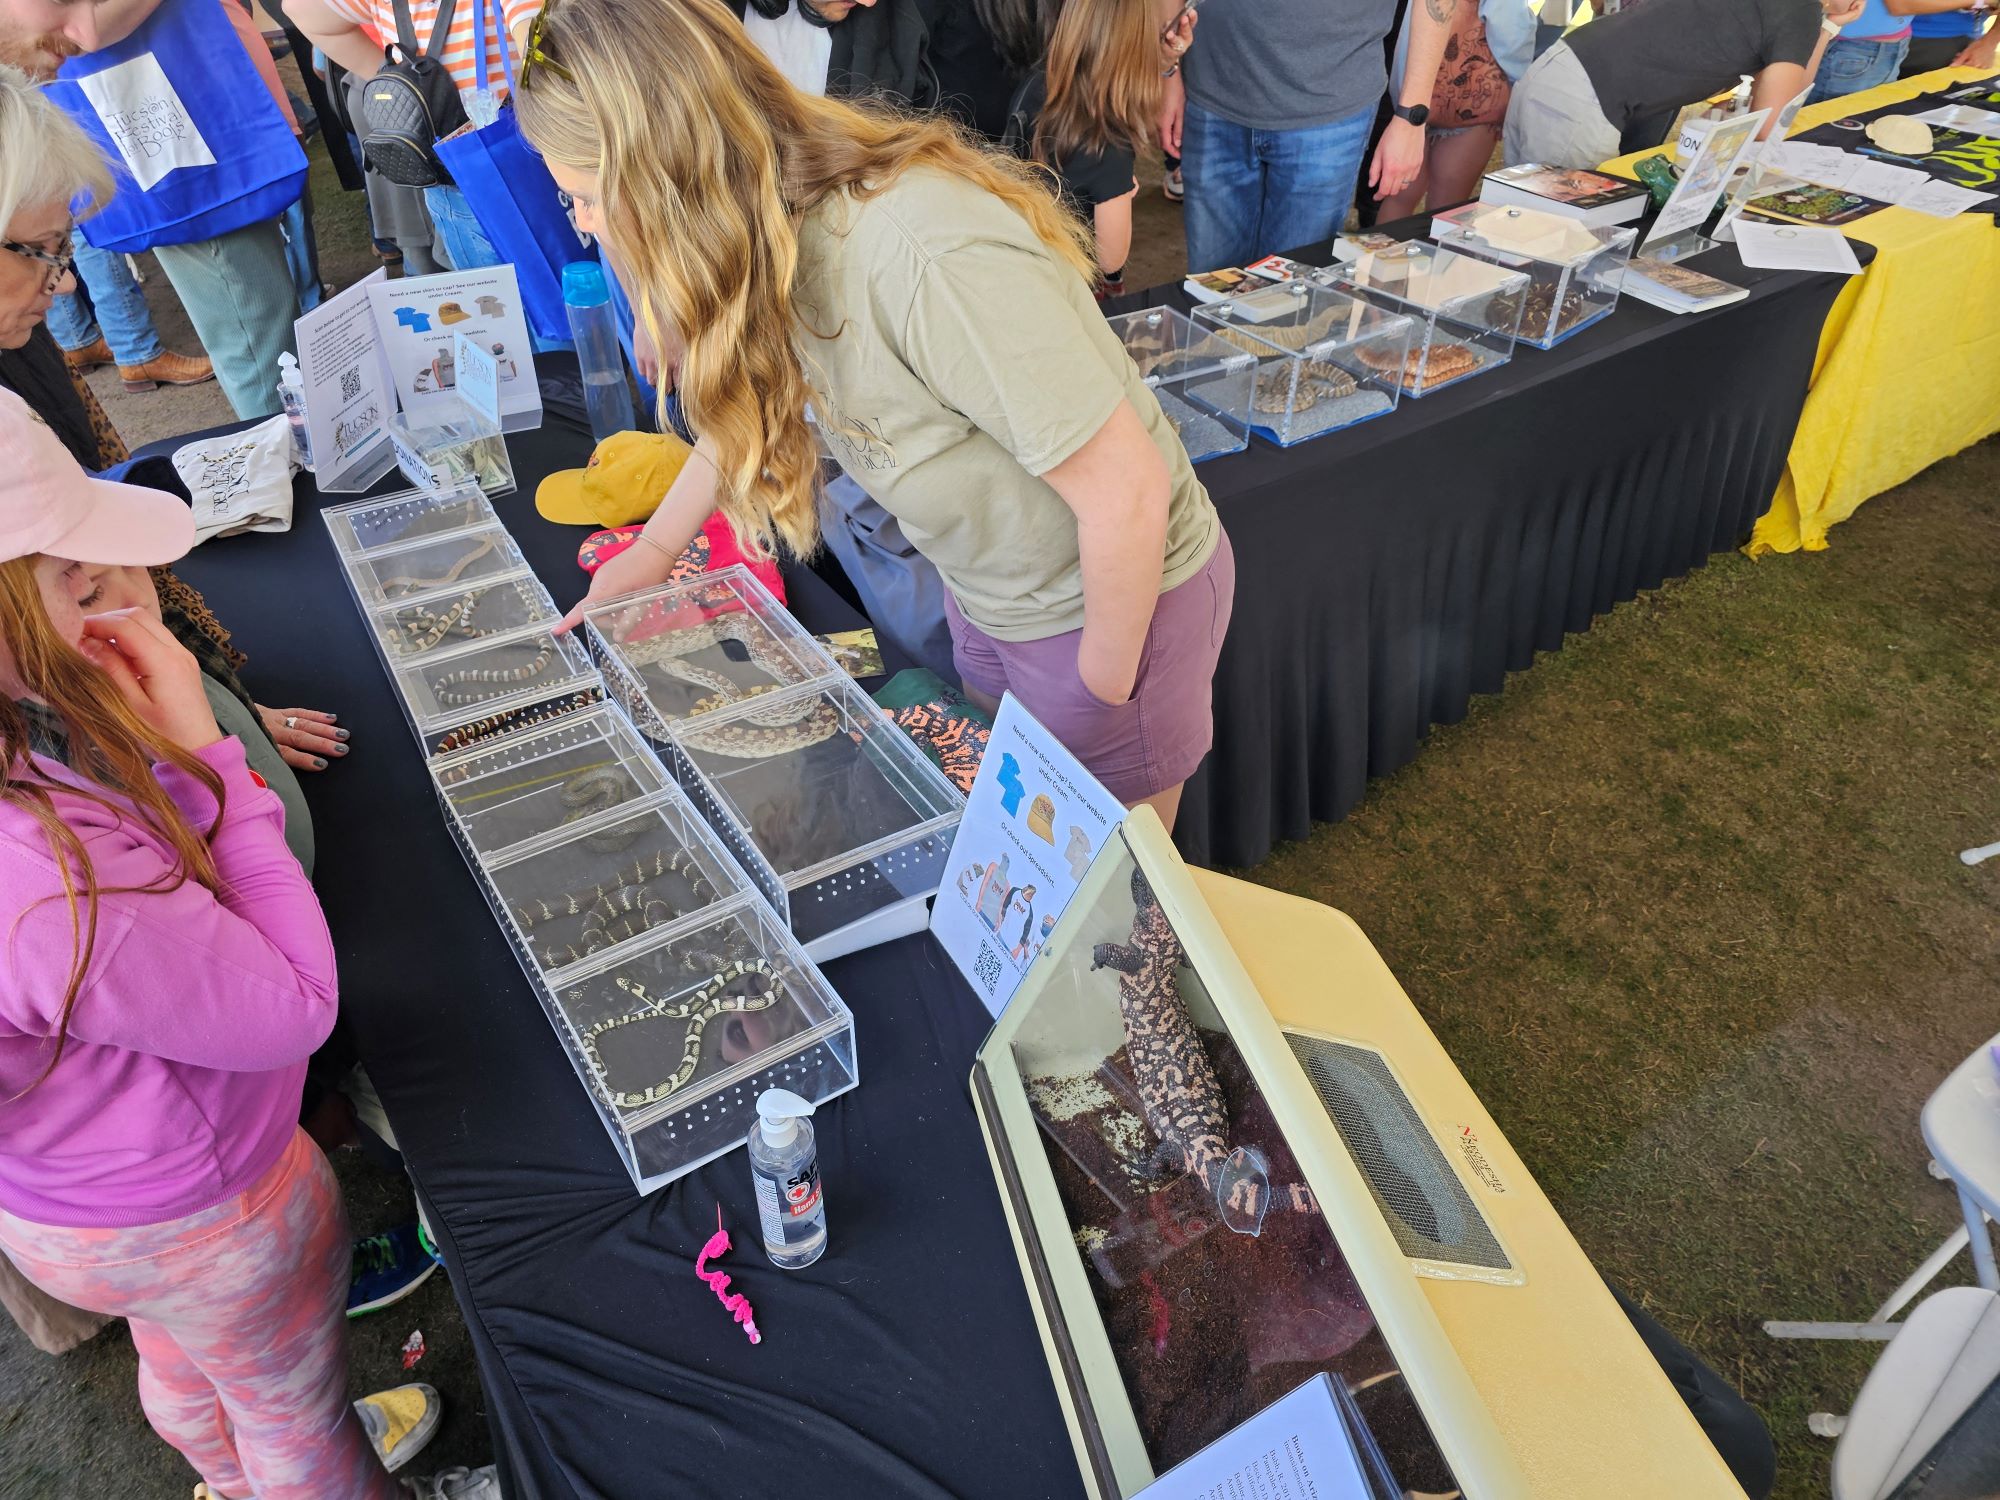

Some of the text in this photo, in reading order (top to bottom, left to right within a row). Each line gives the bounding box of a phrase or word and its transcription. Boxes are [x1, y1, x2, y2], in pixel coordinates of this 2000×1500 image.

[105, 99, 169, 133] Tucson
[115, 101, 183, 158] Festival
[137, 122, 187, 158] Books
[1012, 725, 1025, 741] Need
[1028, 742, 1039, 755] new
[1038, 752, 1051, 767] shirt
[1050, 764, 1057, 772] or
[1055, 770, 1068, 785] cap?
[1067, 782, 1077, 795] See
[1077, 793, 1087, 804] our
[1086, 802, 1107, 826] website
[1038, 767, 1069, 802] under Cream.
[1001, 821, 1007, 831] Or
[1007, 829, 1020, 846] check
[1019, 844, 1029, 856] out
[793, 1197, 816, 1215] Hand
[1283, 1439, 1306, 1498] inconsistencies
[1291, 1434, 1305, 1466] Books
[1302, 1465, 1310, 1477] on
